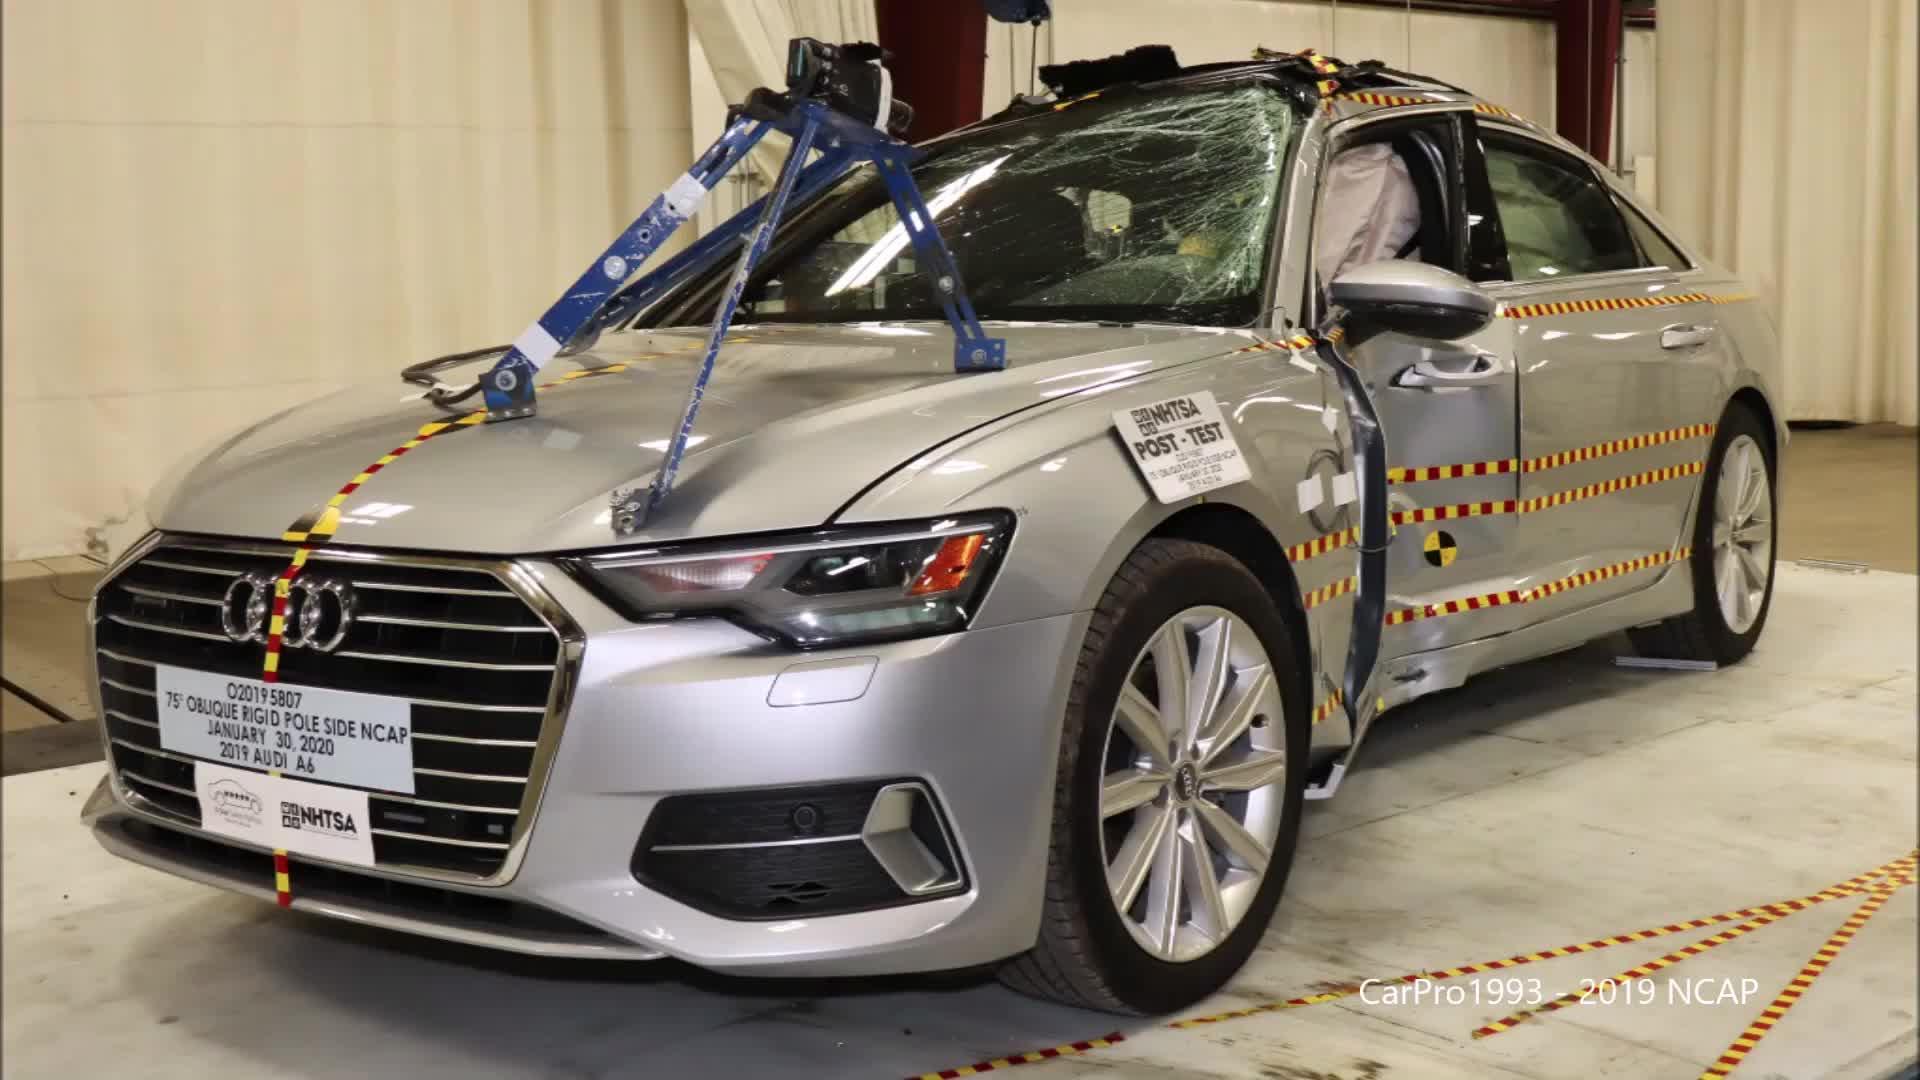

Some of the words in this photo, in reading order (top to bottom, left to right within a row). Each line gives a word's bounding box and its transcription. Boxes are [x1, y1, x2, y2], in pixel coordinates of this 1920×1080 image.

[1149, 397, 1201, 427] NHTSA
[1134, 433, 1180, 461] POST
[1185, 421, 1225, 446] TEST
[186, 695, 239, 721] OBLIQUE
[242, 705, 280, 727] RIGID
[284, 711, 320, 734] POLE
[323, 717, 357, 739] SIDE
[360, 722, 408, 744] NCAP
[208, 720, 266, 745] JANUARY
[299, 735, 335, 756] 2020
[220, 741, 250, 761] 2019
[253, 747, 287, 769] AUDI
[295, 755, 315, 774] A6
[300, 806, 357, 834] NHTSA
